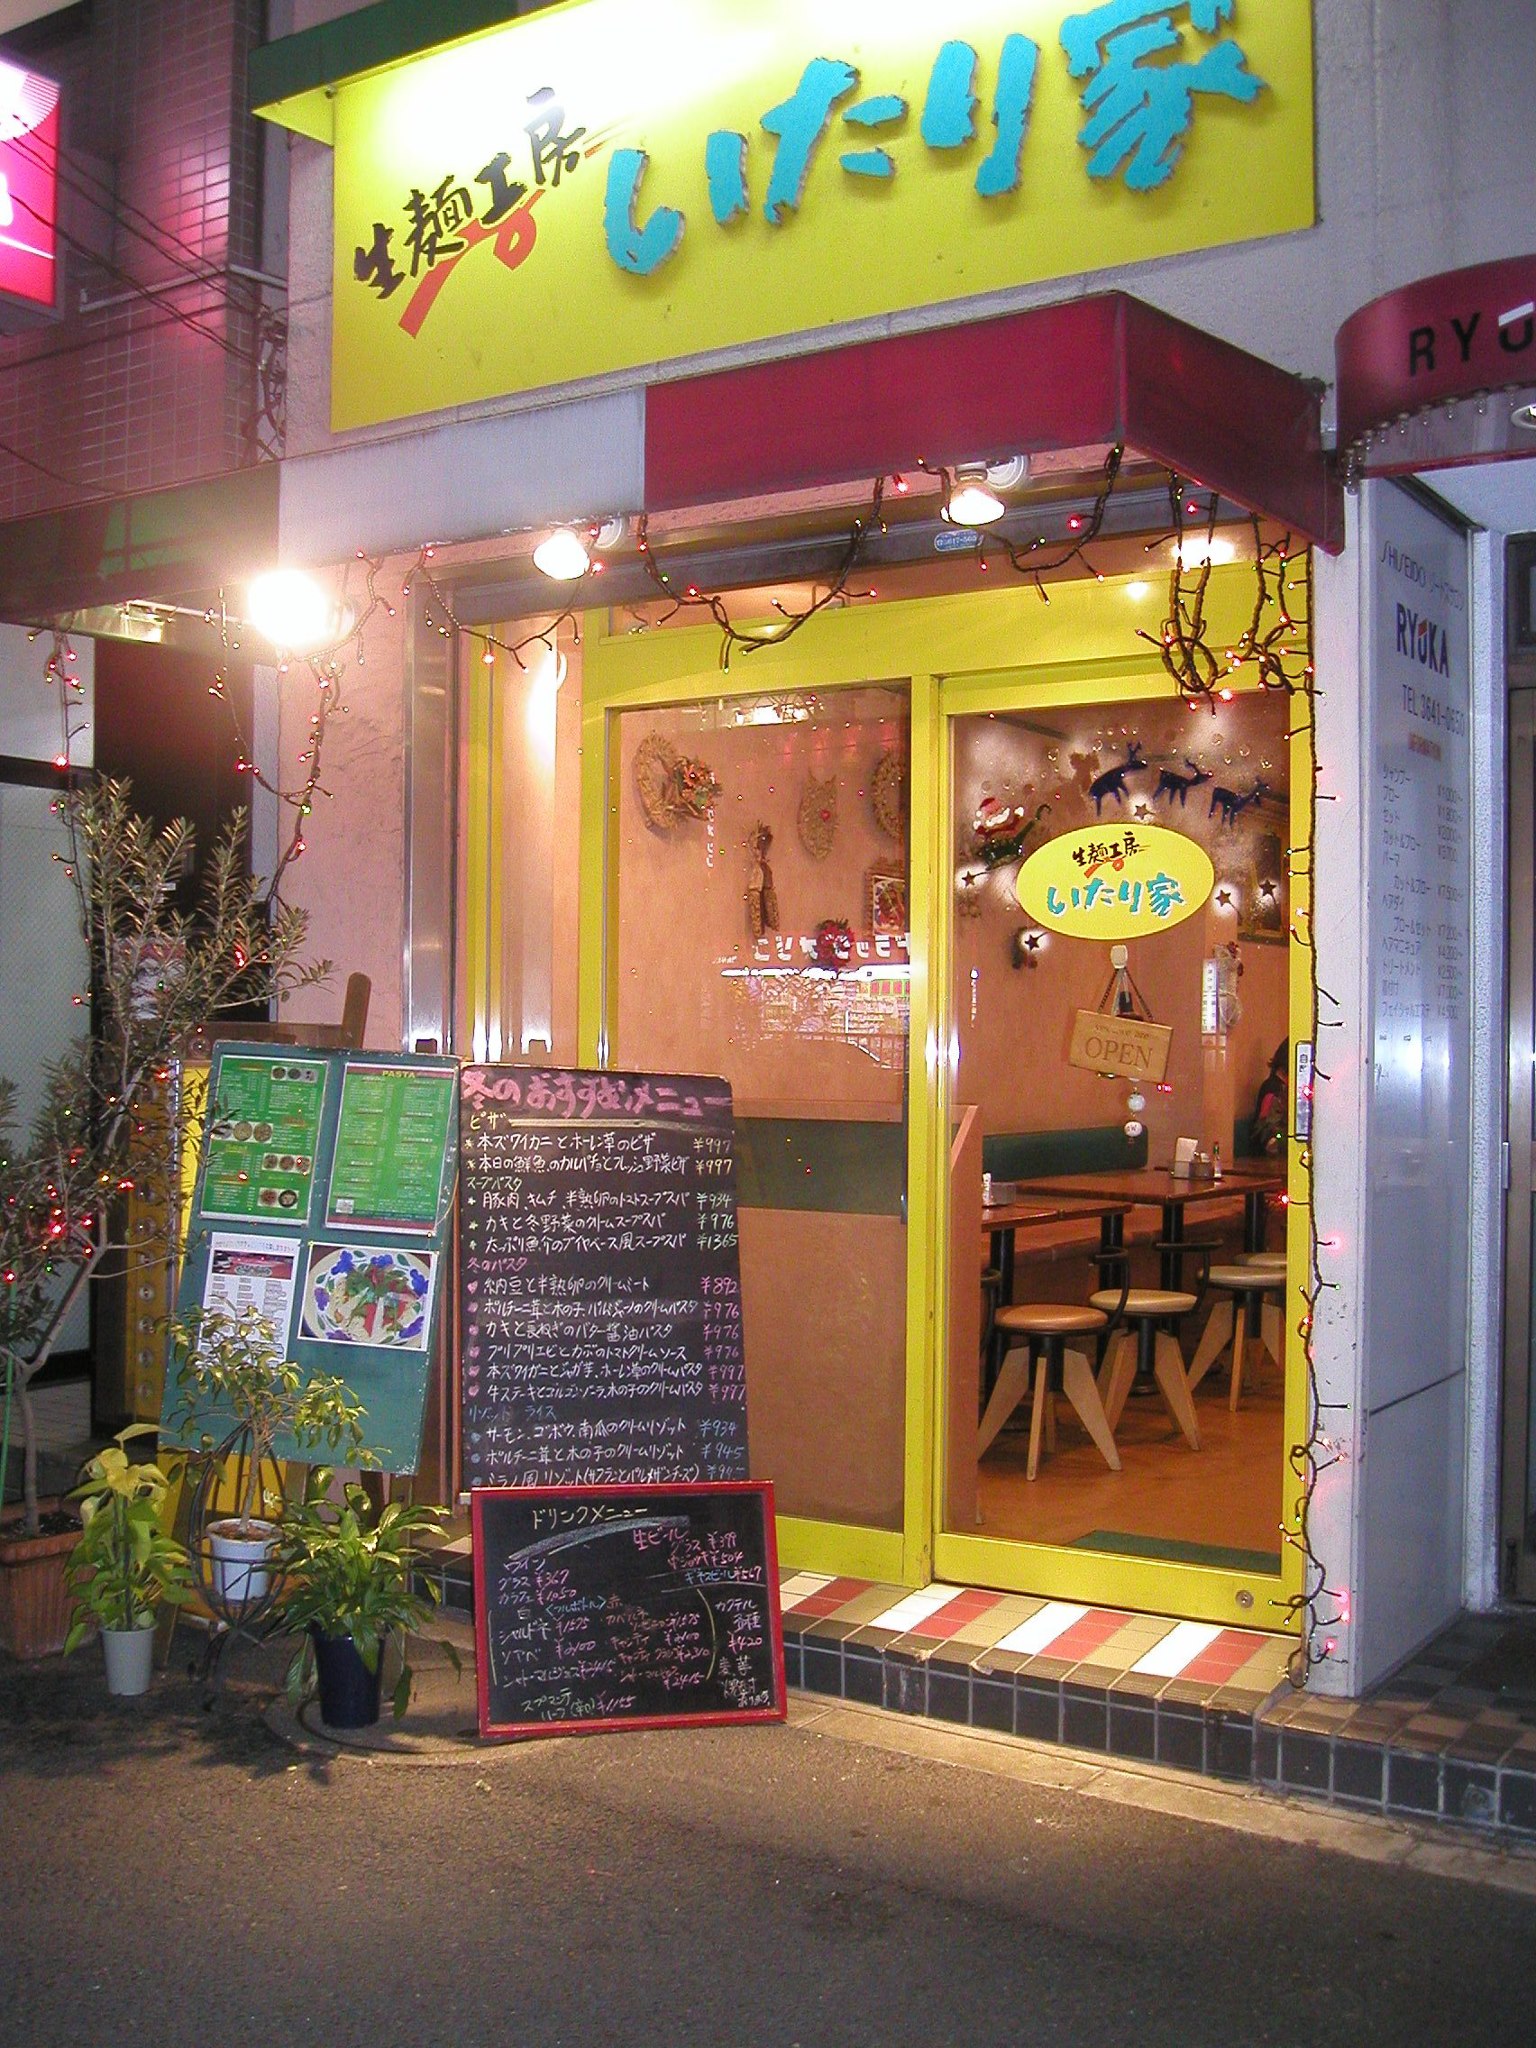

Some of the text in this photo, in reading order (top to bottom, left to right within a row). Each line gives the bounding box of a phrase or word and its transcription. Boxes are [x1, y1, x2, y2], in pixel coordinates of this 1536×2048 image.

[603, 0, 1269, 277] いたり家
[353, 87, 586, 300] 生麺工房
[1381, 540, 1427, 590] SHISEIDO
[1401, 684, 1418, 718] TEL
[1072, 831, 1140, 867] 生麺工房
[1046, 872, 1185, 917] いたり家
[1085, 1036, 1153, 1069] OPEN
[382, 1069, 416, 1079] PASTA
[470, 1112, 507, 1130] ピザ
[694, 1137, 731, 1152] ¥997
[696, 1158, 733, 1175] ¥997
[697, 1192, 732, 1211] ¥934
[697, 1213, 734, 1230] ¥976
[697, 1232, 738, 1250] ¥1365
[700, 1276, 740, 1296] ¥892
[703, 1301, 740, 1321] ¥976
[703, 1323, 740, 1341] ¥976
[704, 1346, 740, 1361] ¥976
[707, 1364, 745, 1382] ¥997
[708, 1382, 747, 1402] ¥997
[700, 1419, 737, 1438] ¥934
[701, 1442, 745, 1459] ¥945
[532, 1504, 649, 1531] ドリンクメニュー
[633, 1526, 689, 1552] 生ビール
[503, 1556, 546, 1574] ワイン
[498, 1568, 570, 1591] グラス ¥367
[517, 1605, 531, 1620] 白
[715, 1597, 758, 1613] カクテル
[499, 1617, 552, 1645] シャルドネ
[727, 1630, 763, 1654] ¥420
